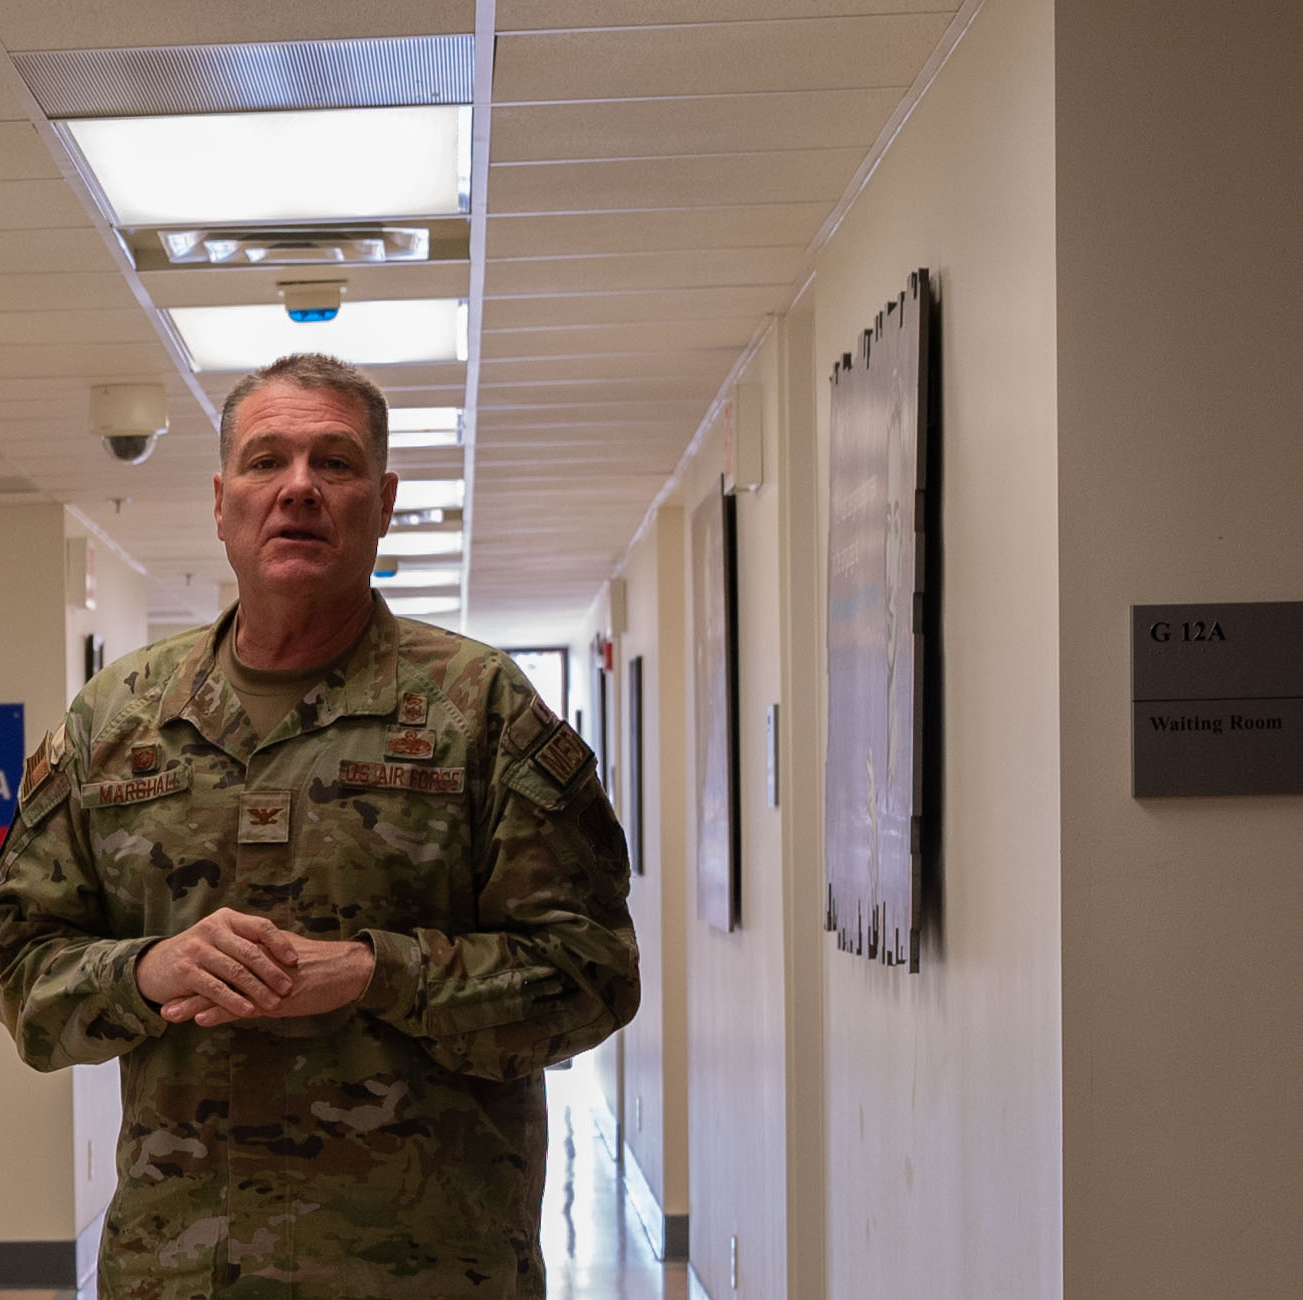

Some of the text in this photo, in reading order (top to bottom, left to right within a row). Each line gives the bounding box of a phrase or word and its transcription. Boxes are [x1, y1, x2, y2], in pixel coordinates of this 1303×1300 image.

[1149, 619, 1227, 643] G 12A
[1150, 714, 1283, 735] Waiting Room
[99, 771, 180, 804] MARSHALL
[378, 765, 406, 786] AIR
[409, 767, 460, 791] FORCE
